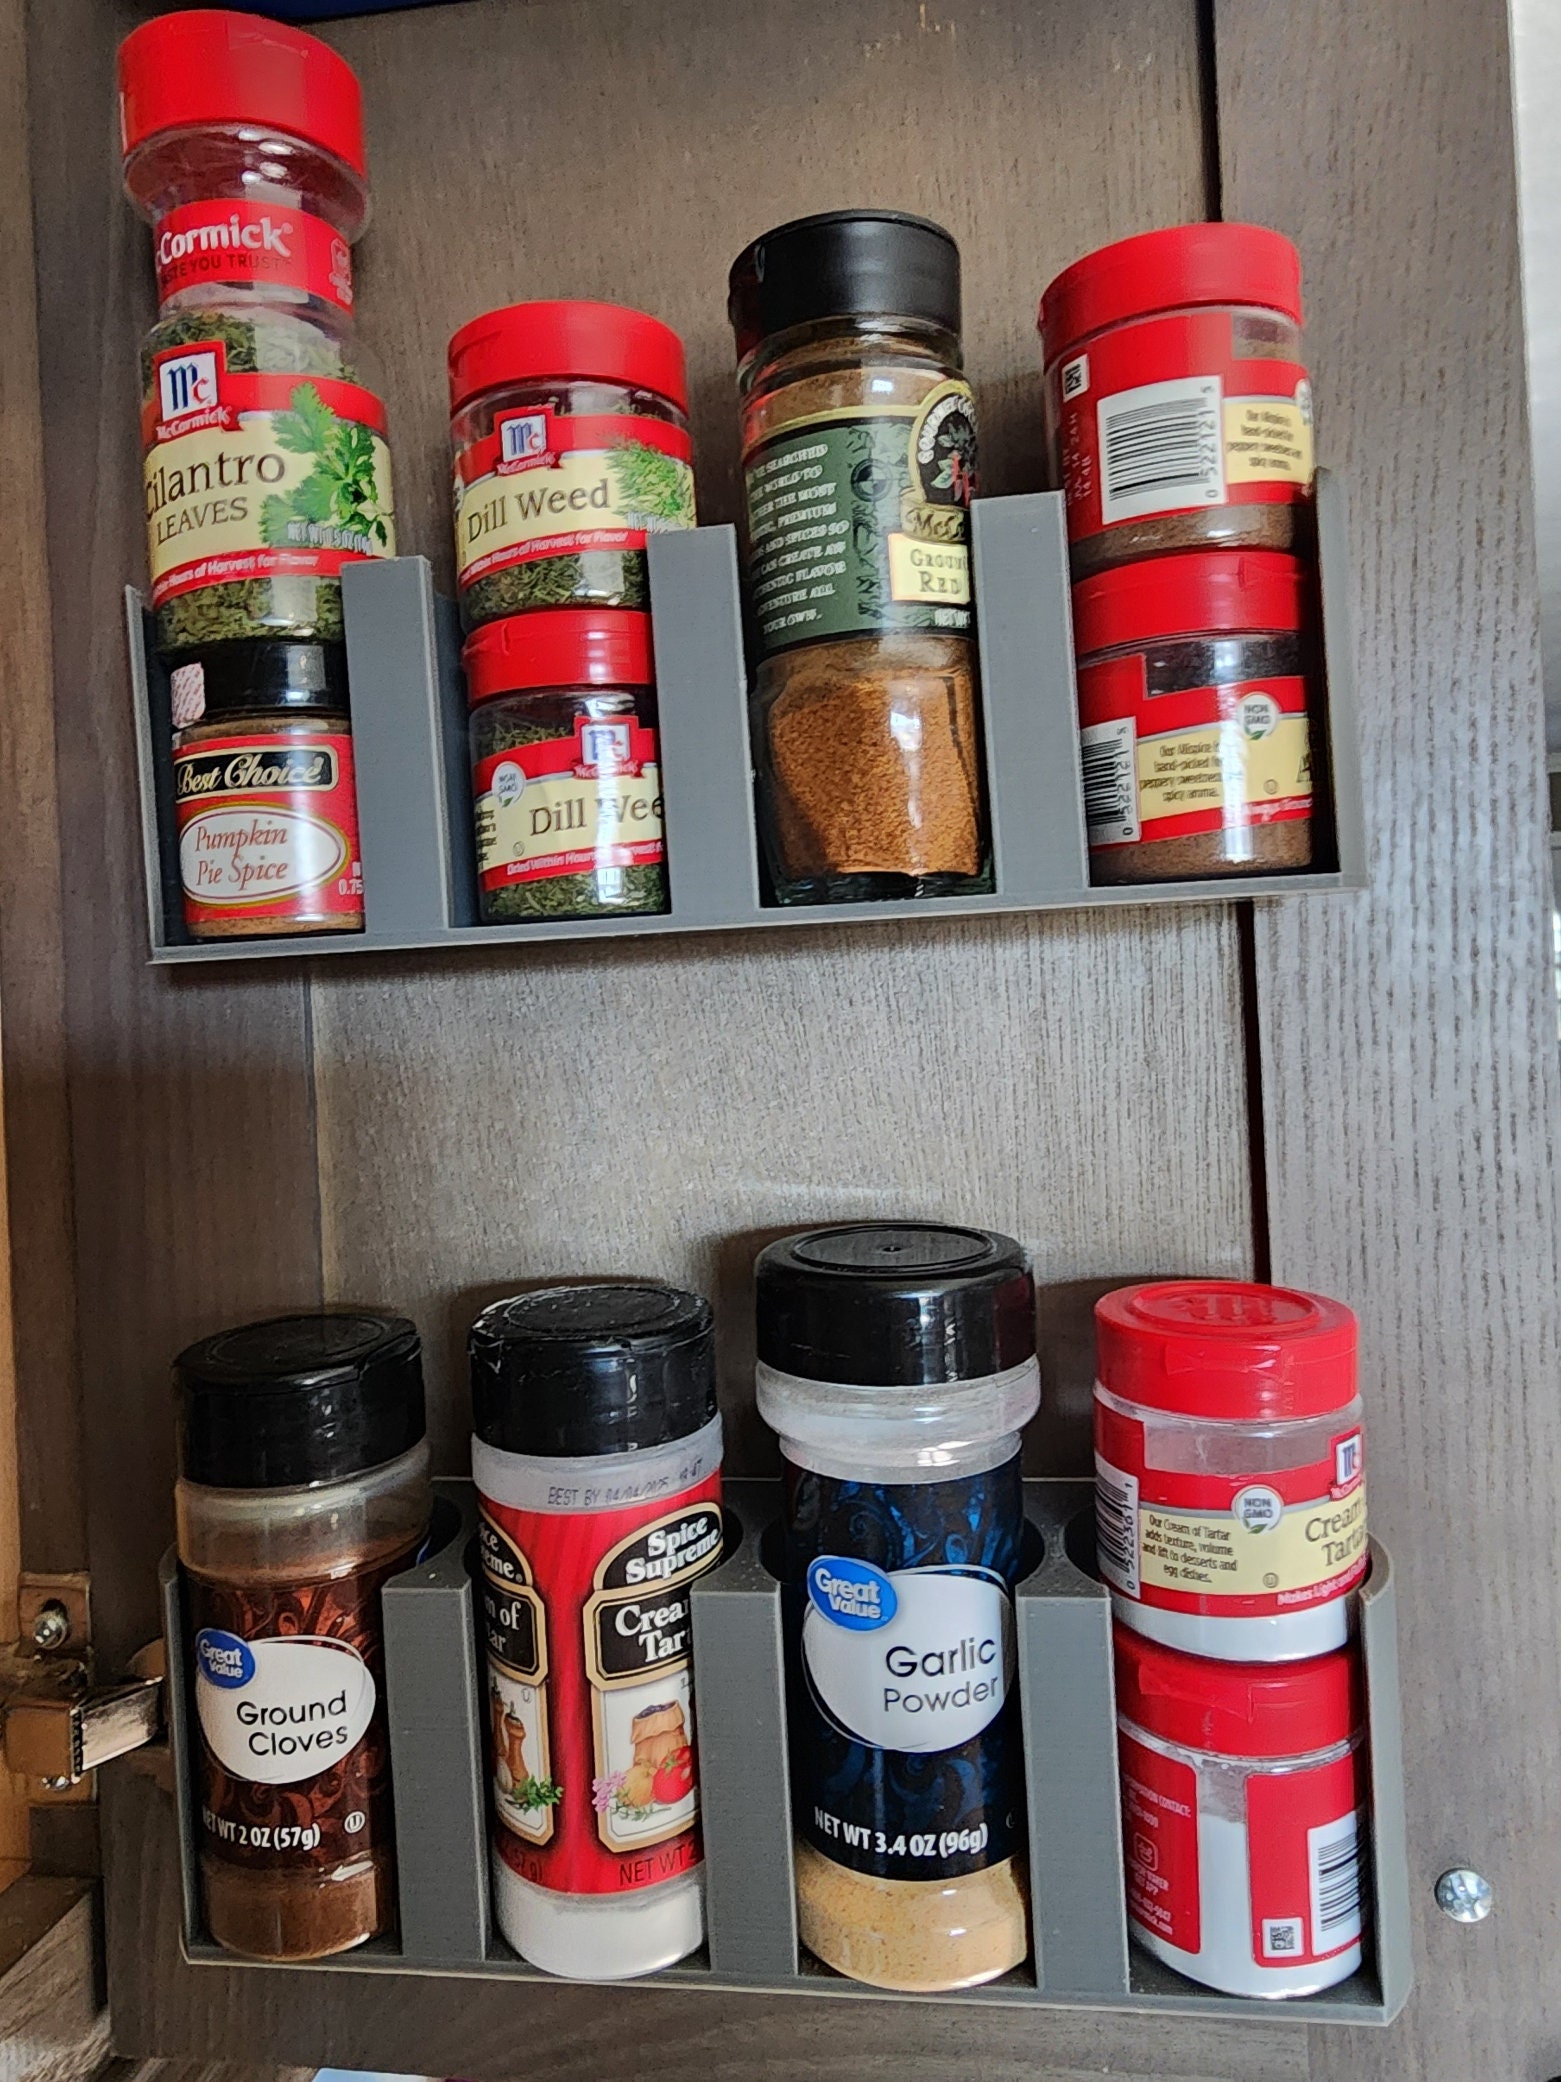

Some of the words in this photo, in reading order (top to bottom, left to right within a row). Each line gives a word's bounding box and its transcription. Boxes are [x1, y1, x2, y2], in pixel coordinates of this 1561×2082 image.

[157, 213, 291, 268] Cormick
[188, 256, 221, 274] YOU
[155, 405, 231, 440] McCormick
[156, 496, 249, 546] LEAVES
[466, 494, 508, 544] Dill
[515, 477, 611, 520] Weed
[918, 570, 962, 595] RED
[177, 762, 222, 796] Best
[224, 754, 324, 789] Choice
[530, 796, 588, 837] Dill
[195, 819, 288, 856] Pumpkin
[196, 859, 222, 887] Pie
[228, 856, 288, 892] Spice
[548, 1486, 579, 1506] BEST
[585, 1489, 599, 1506] BY
[1243, 1497, 1272, 1509] NON
[1149, 1514, 1162, 1528] Our
[1164, 1518, 1190, 1535] Cream
[1202, 1526, 1231, 1541] Tartar
[1243, 1509, 1273, 1520] GMO
[648, 1517, 708, 1557] Spice
[625, 1528, 719, 1584] Supreme
[1163, 1564, 1179, 1579] egg
[814, 1567, 883, 1605] Great
[500, 1601, 522, 1631] of
[828, 1596, 882, 1621] Value
[201, 1639, 243, 1667] Great
[638, 1629, 686, 1663] Tar
[886, 1637, 997, 1678] Garlic
[209, 1660, 244, 1678] Value
[236, 1690, 347, 1726] Ground
[883, 1675, 999, 1713] Powder
[248, 1726, 348, 1756] Cloves
[217, 1818, 236, 1842] WT
[238, 1825, 248, 1845] 2
[250, 1826, 271, 1848] OZ
[273, 1822, 321, 1851] (57g)
[814, 1806, 840, 1838] NET
[843, 1822, 871, 1850] WT
[874, 1831, 907, 1857] 3.4
[909, 1834, 936, 1857] OZ
[939, 1823, 989, 1859] (96g)
[619, 1857, 655, 1886] NET
[658, 1845, 686, 1874] WT
